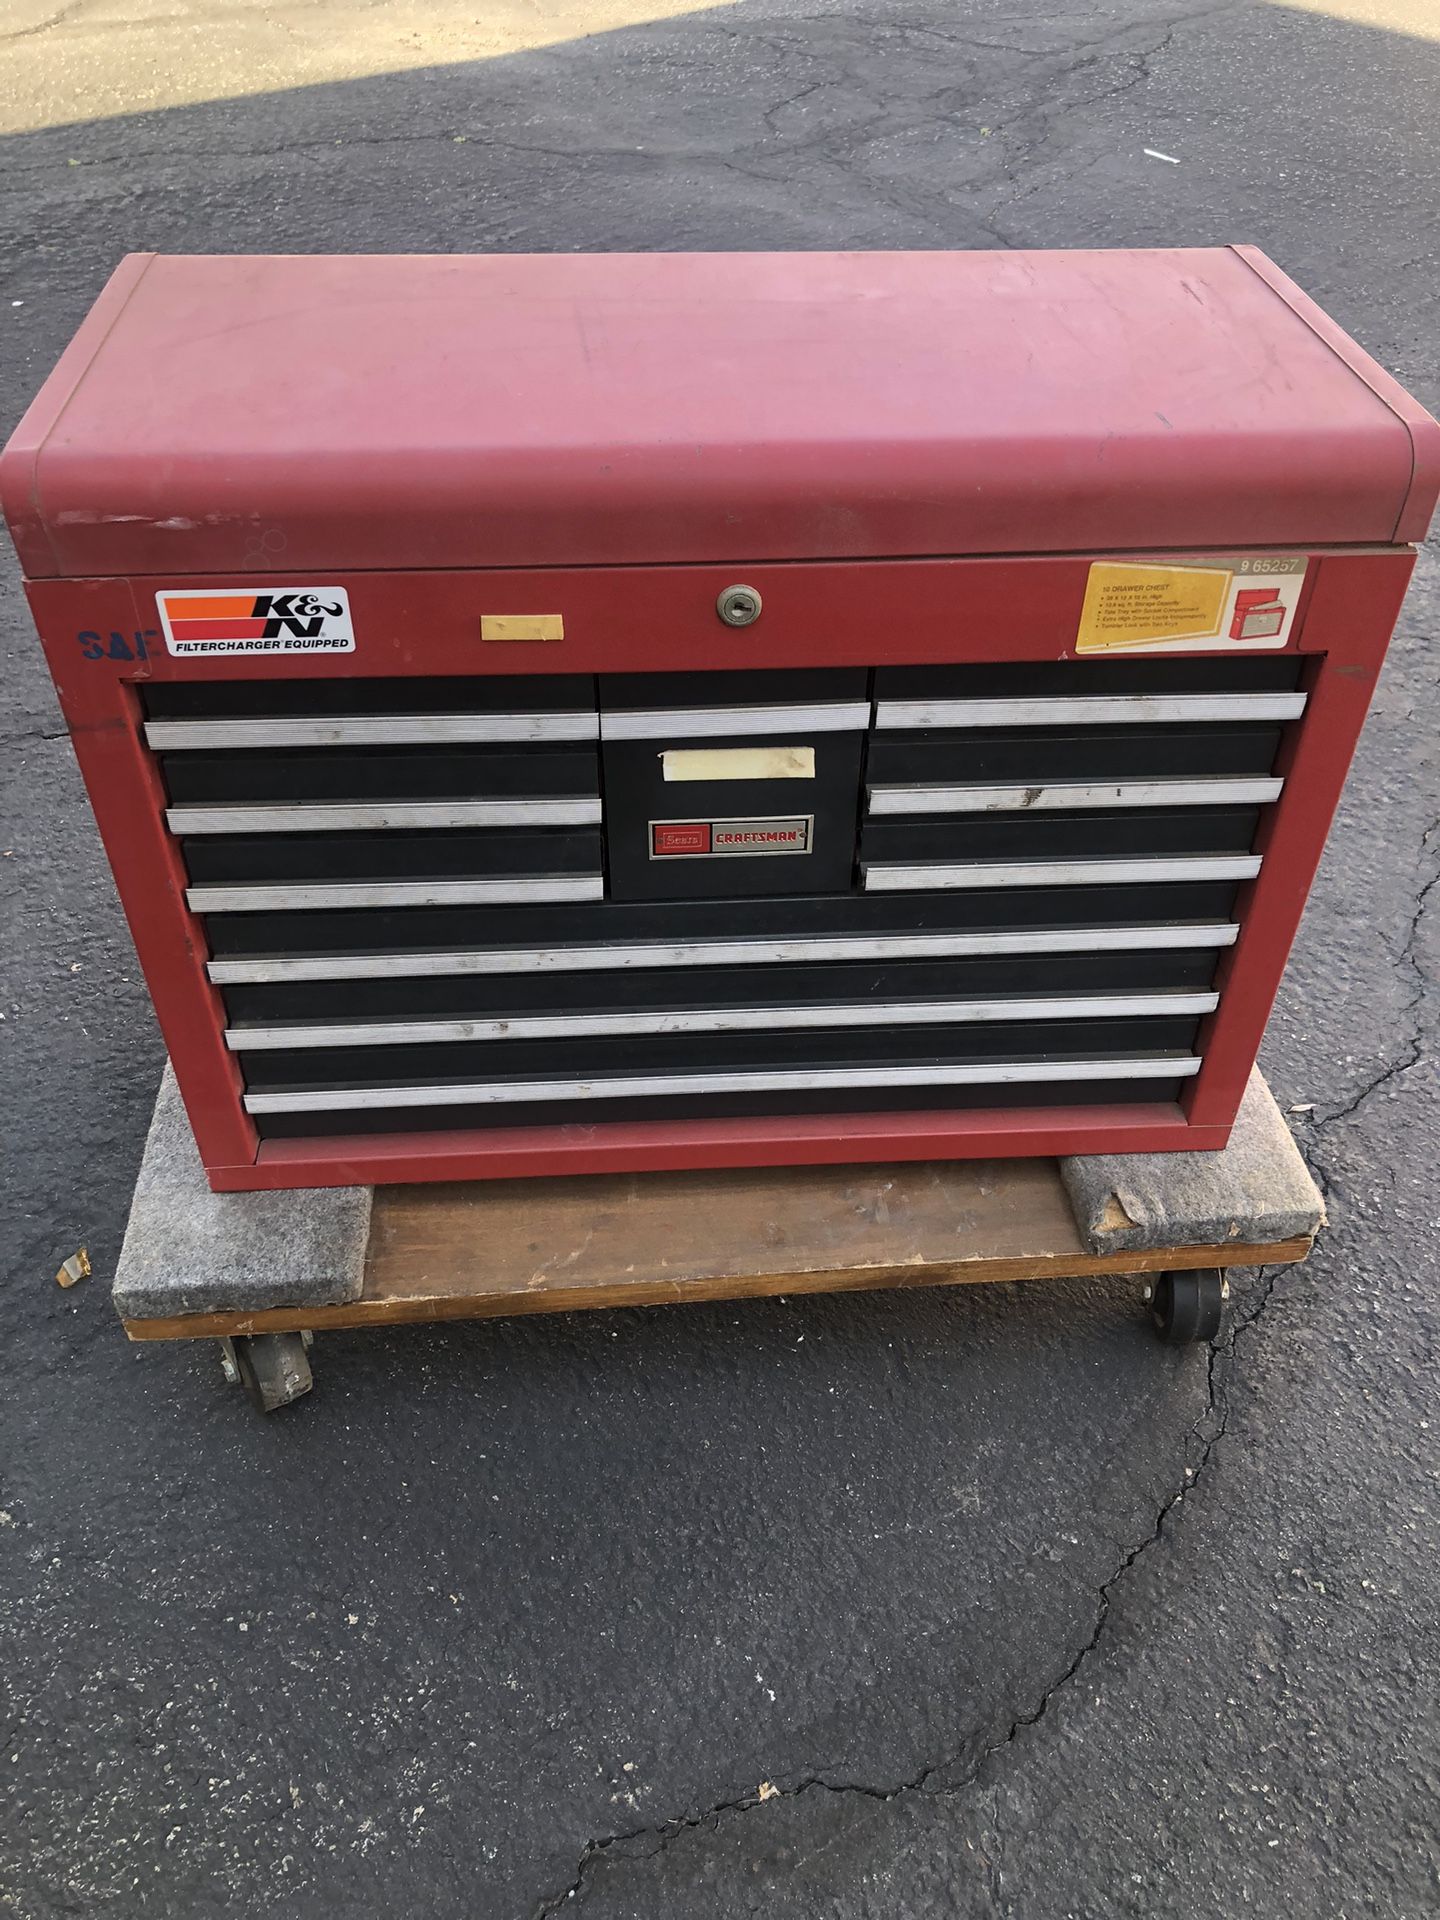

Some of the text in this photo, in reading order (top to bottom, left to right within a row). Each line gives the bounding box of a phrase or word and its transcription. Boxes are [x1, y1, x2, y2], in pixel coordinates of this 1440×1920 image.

[1241, 559, 1299, 573] 9 65257
[1145, 583, 1170, 591] CHEST
[1135, 600, 1156, 608] Storage
[176, 639, 349, 652] FILTERCHARGER EQUIPPED
[666, 831, 797, 845] Sears CRAFTSMAN
